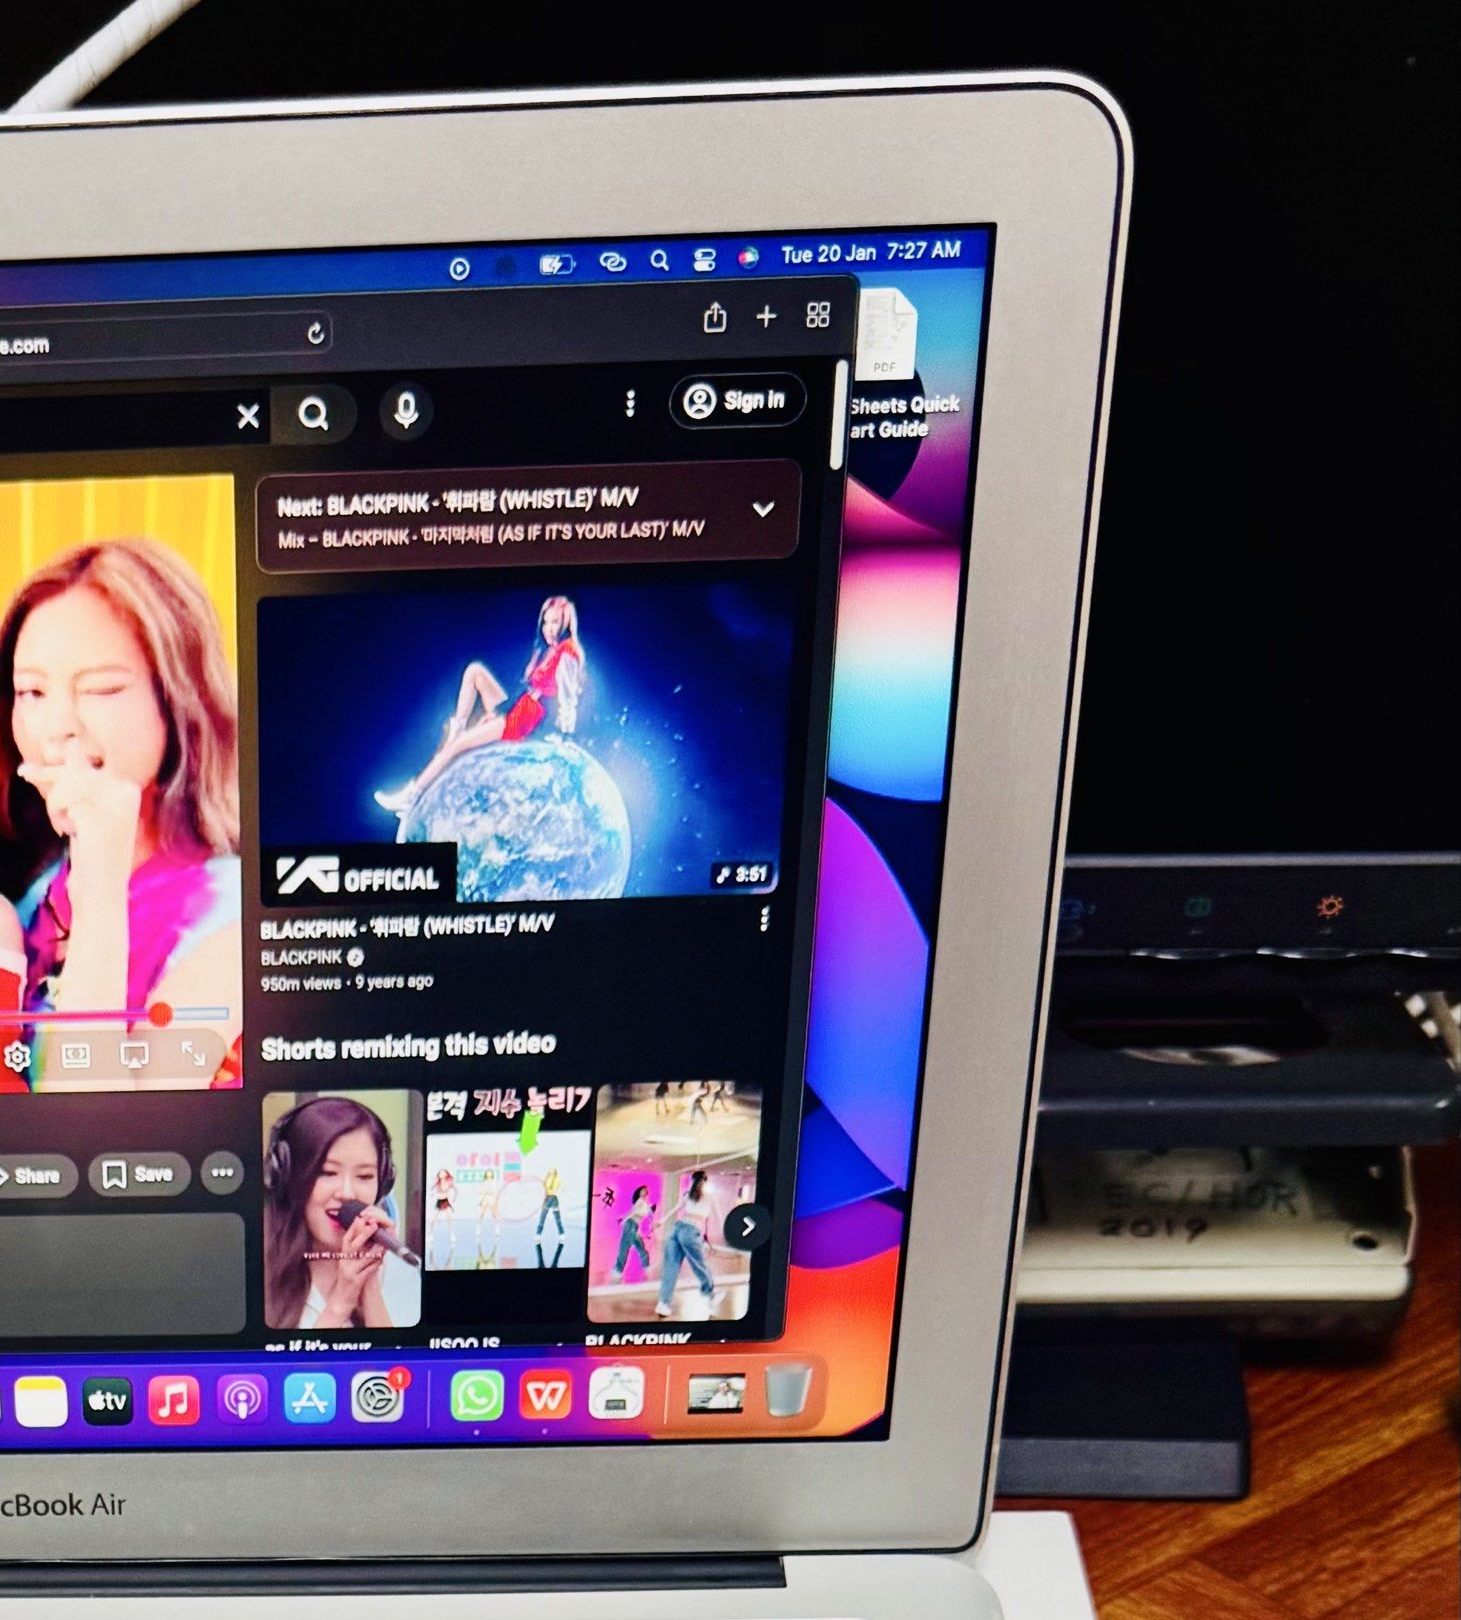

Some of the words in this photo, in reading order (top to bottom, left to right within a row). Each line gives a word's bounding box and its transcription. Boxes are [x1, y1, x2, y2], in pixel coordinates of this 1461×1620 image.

[782, 246, 812, 264] Tue
[818, 244, 842, 262] 20
[846, 244, 876, 262] Jan
[888, 242, 926, 260] 7:27
[931, 240, 960, 258] AM
[874, 362, 897, 372] PDF
[724, 391, 764, 414] Sign
[768, 389, 785, 409] in
[851, 398, 907, 415] Sheets
[910, 395, 960, 414] Quick
[850, 423, 874, 439] art
[878, 421, 929, 439] Guide
[278, 496, 323, 518] Next:
[327, 493, 429, 517] BLACKPINK
[601, 486, 639, 508] M/V
[278, 530, 305, 549] Mix
[323, 528, 410, 548] BLACKPINK
[498, 525, 525, 545] (AS
[528, 525, 542, 542] IF
[545, 523, 573, 541] IT'S
[575, 522, 617, 541] YOUR
[672, 519, 705, 538] M/V
[344, 867, 439, 893] OFFICIAL
[736, 865, 768, 882] 3:51
[261, 919, 357, 941] BLACKPINK
[518, 913, 555, 934] M/V
[261, 949, 342, 966] BLACKPINK
[261, 975, 300, 992] 950m
[303, 975, 341, 991] views
[355, 975, 364, 991] 9
[367, 975, 405, 991] years
[407, 975, 434, 990] ago
[261, 1037, 336, 1061] Shorts
[341, 1034, 440, 1062] remixing
[445, 1032, 489, 1058] this
[493, 1032, 556, 1055] video
[14, 1166, 60, 1185] Share
[135, 1165, 172, 1184] Save
[1099, 1218, 1208, 1244] 2019
[106, 1391, 126, 1410] tv
[90, 1492, 126, 1516] Air
